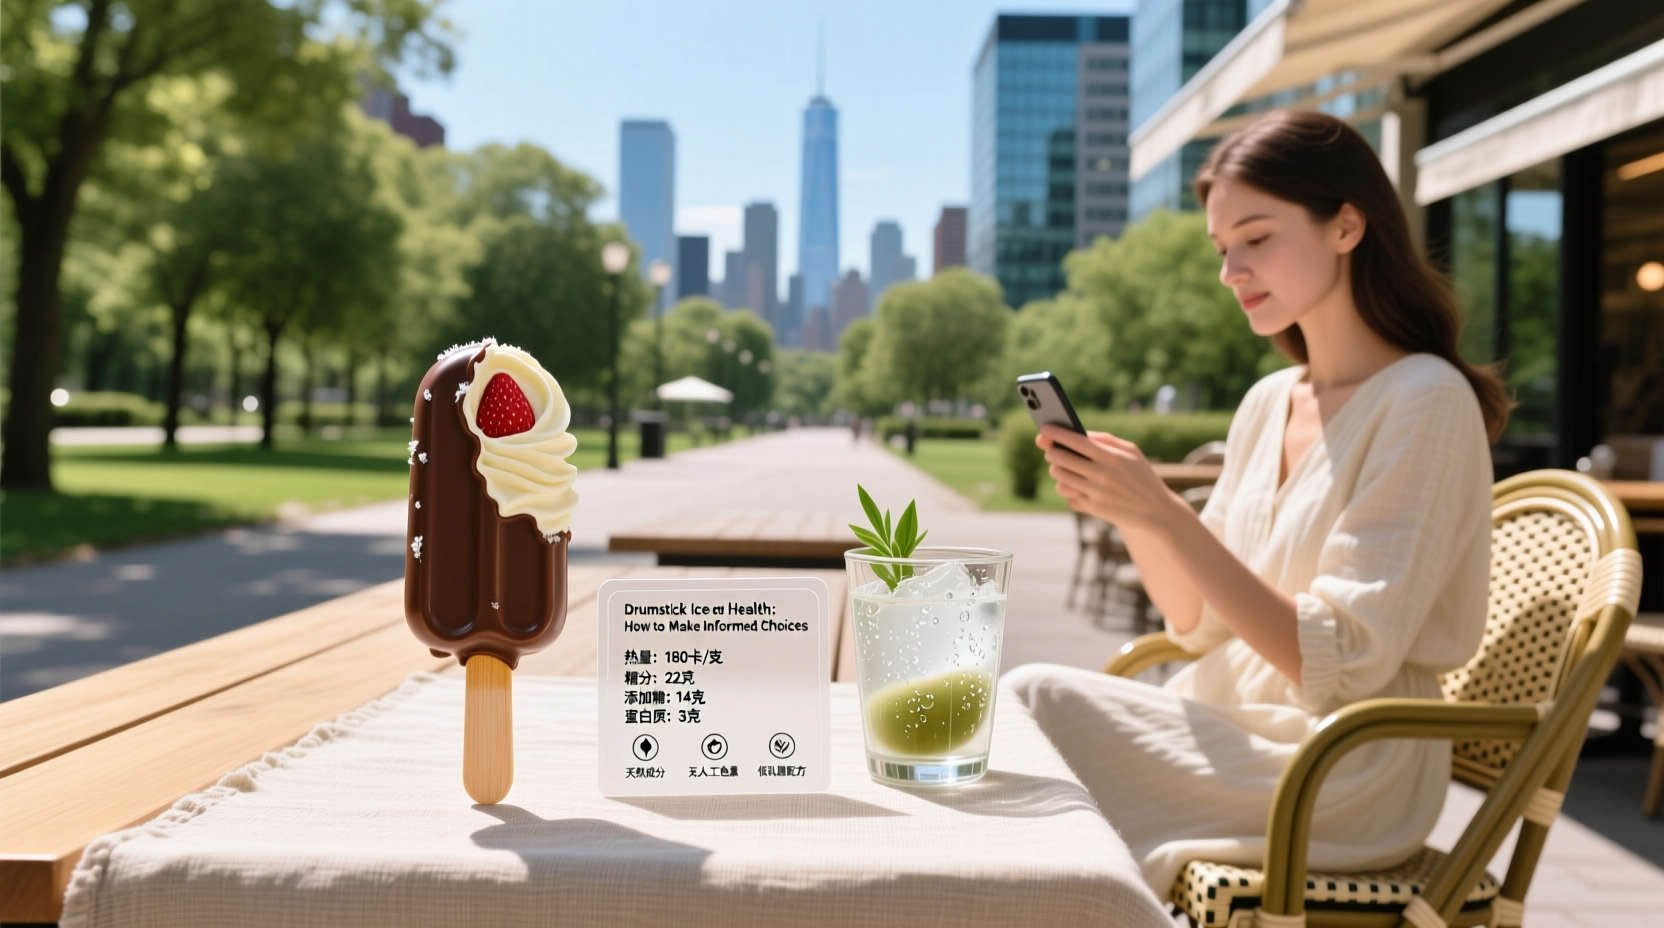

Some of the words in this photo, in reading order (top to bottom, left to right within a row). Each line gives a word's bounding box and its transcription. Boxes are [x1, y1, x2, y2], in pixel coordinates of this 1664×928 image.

[624, 602, 687, 616] Drumstick
[691, 602, 711, 616] Ice
[728, 601, 776, 616] Health:
[624, 620, 651, 632] How
[653, 621, 666, 632] to
[669, 619, 701, 632] Make
[703, 619, 758, 632] Informed
[760, 619, 809, 632] Choices
